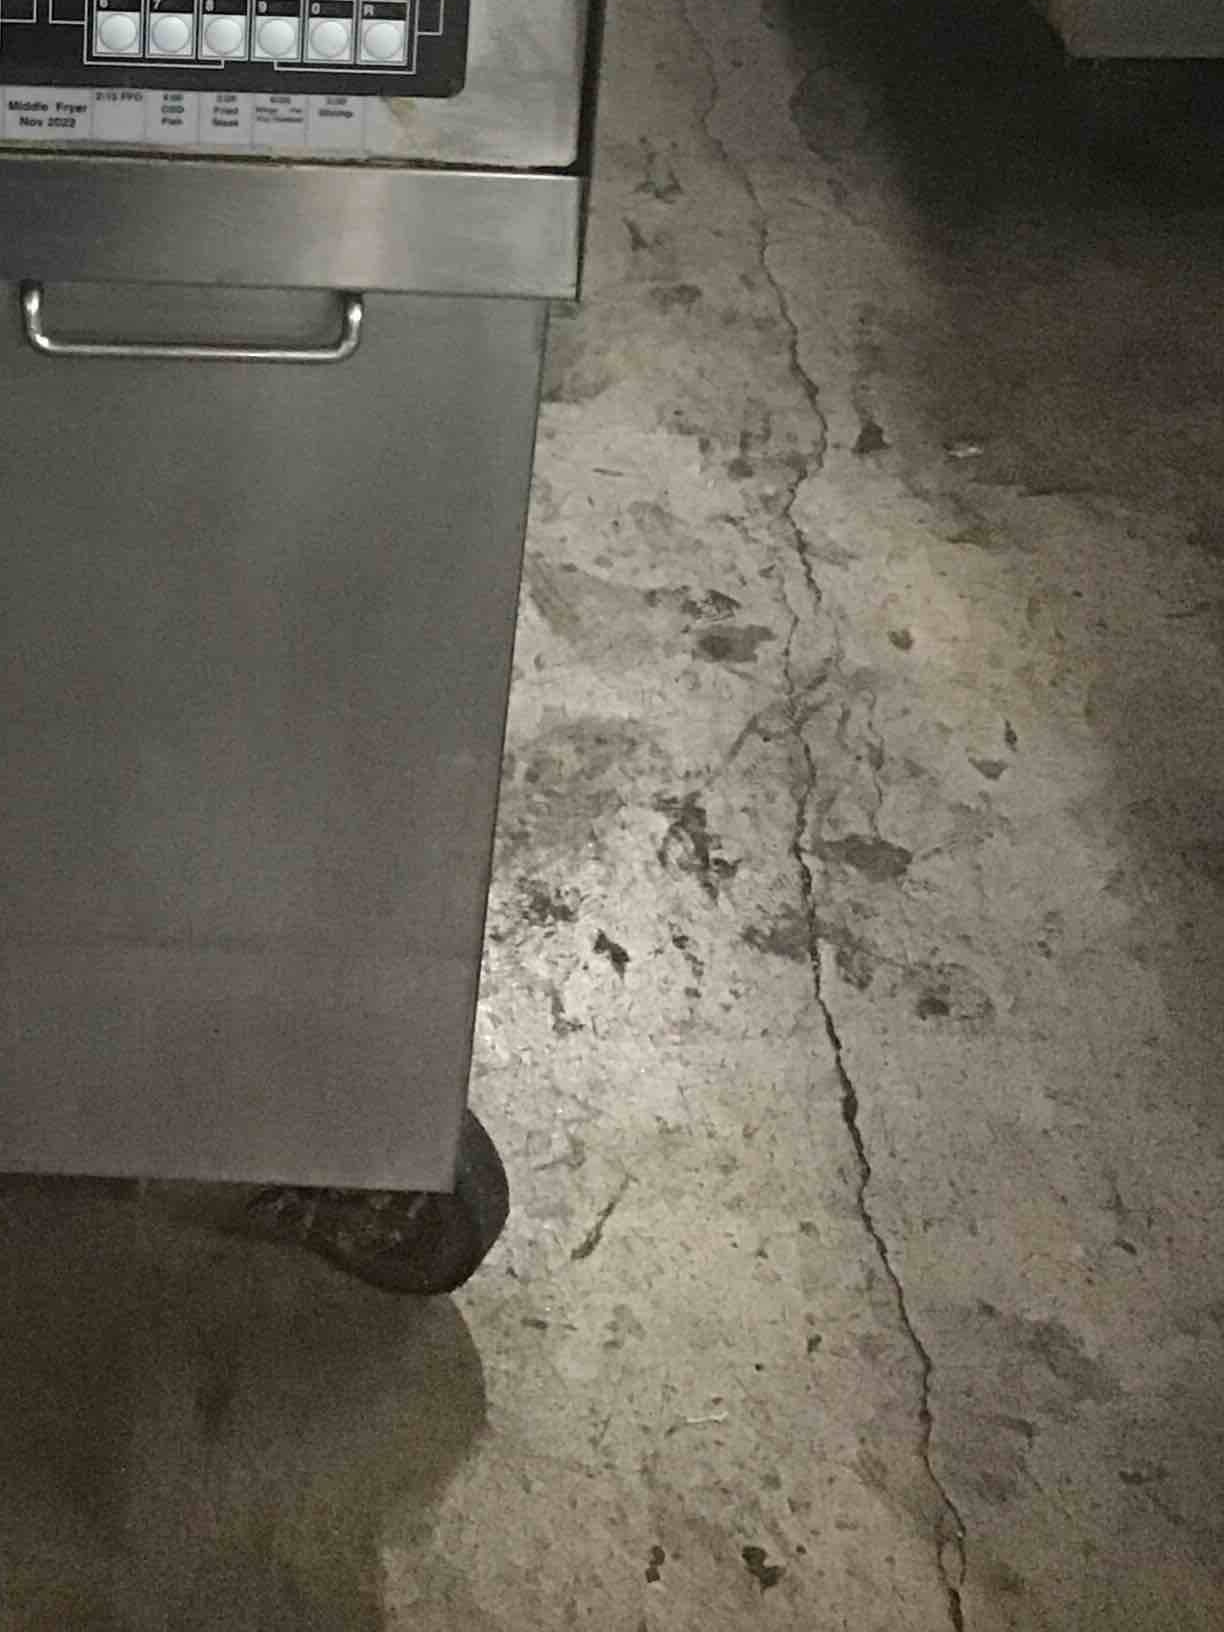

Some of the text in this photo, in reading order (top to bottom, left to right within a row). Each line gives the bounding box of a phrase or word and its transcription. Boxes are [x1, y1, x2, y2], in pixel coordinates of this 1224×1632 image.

[258, 1, 268, 13] 9
[363, 5, 375, 16] R
[8, 100, 87, 114] Middle Fryer
[19, 116, 44, 128] Nov
